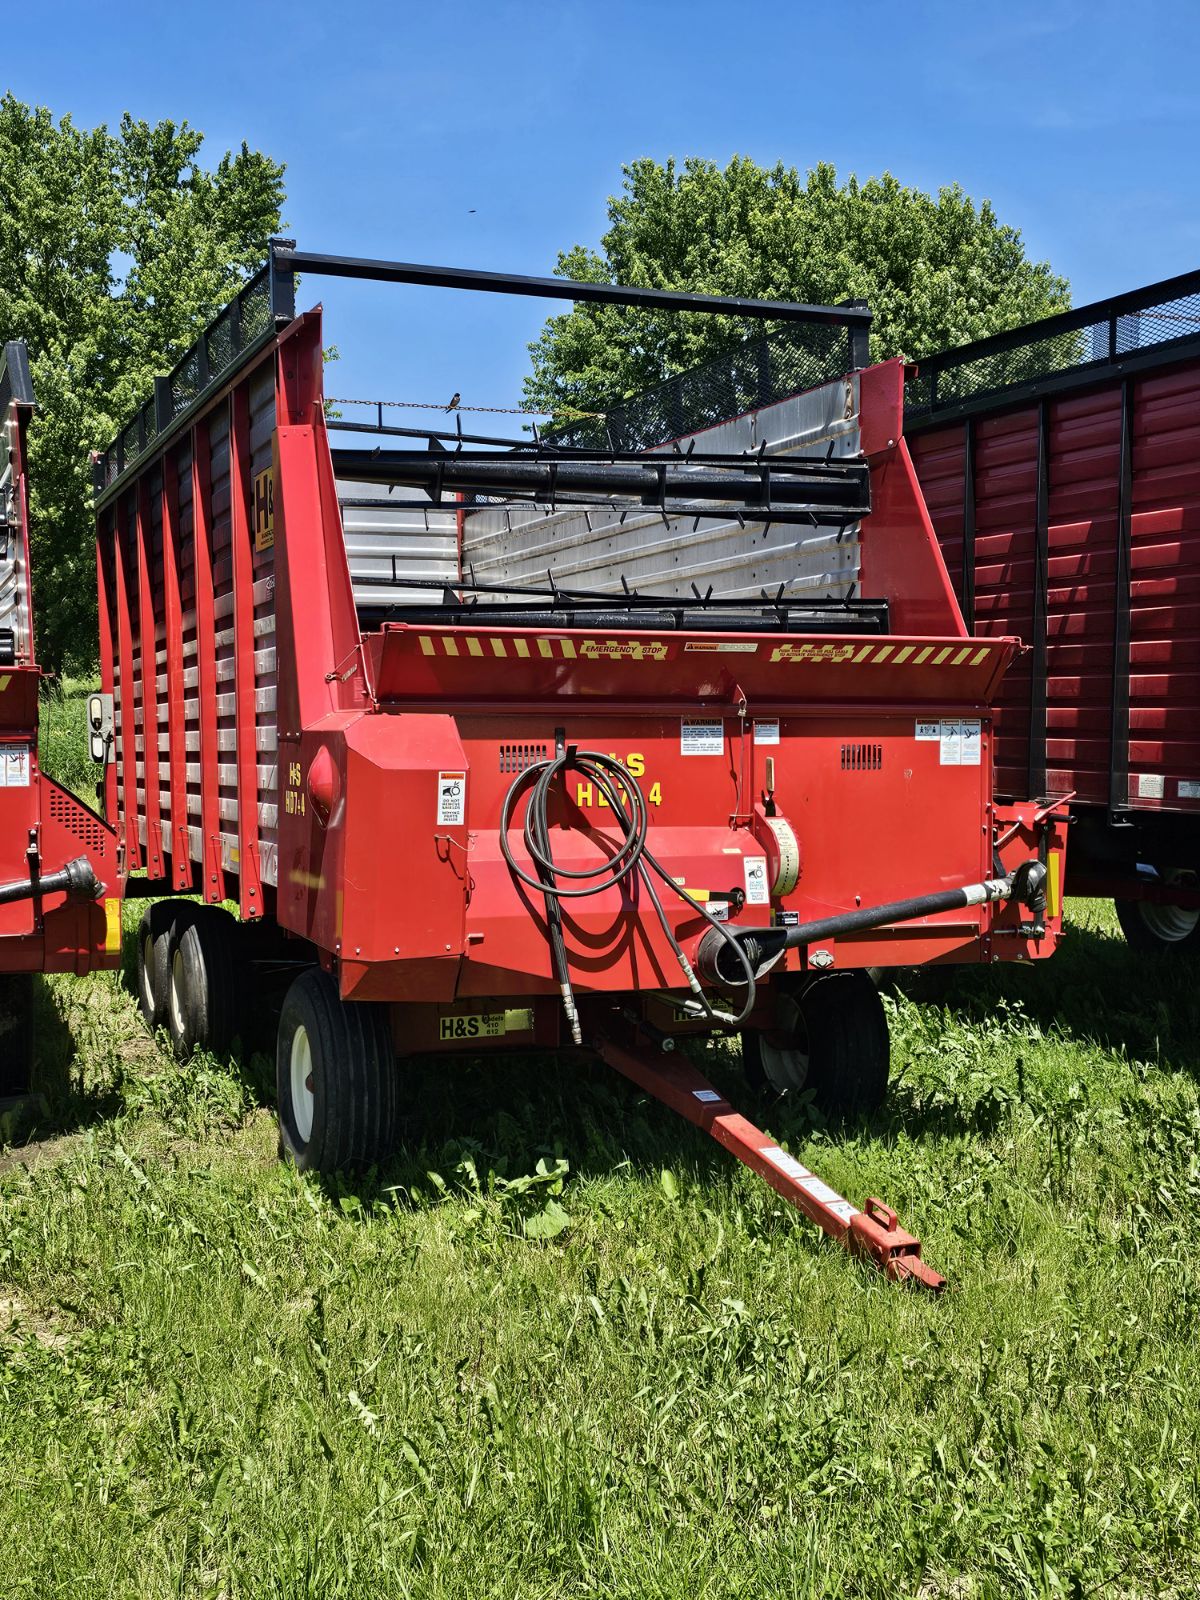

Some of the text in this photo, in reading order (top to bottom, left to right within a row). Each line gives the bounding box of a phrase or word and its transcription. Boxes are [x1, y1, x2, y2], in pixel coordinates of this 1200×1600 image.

[585, 645, 663, 654] EMERGENCY STOP
[441, 1017, 480, 1038] H&S
